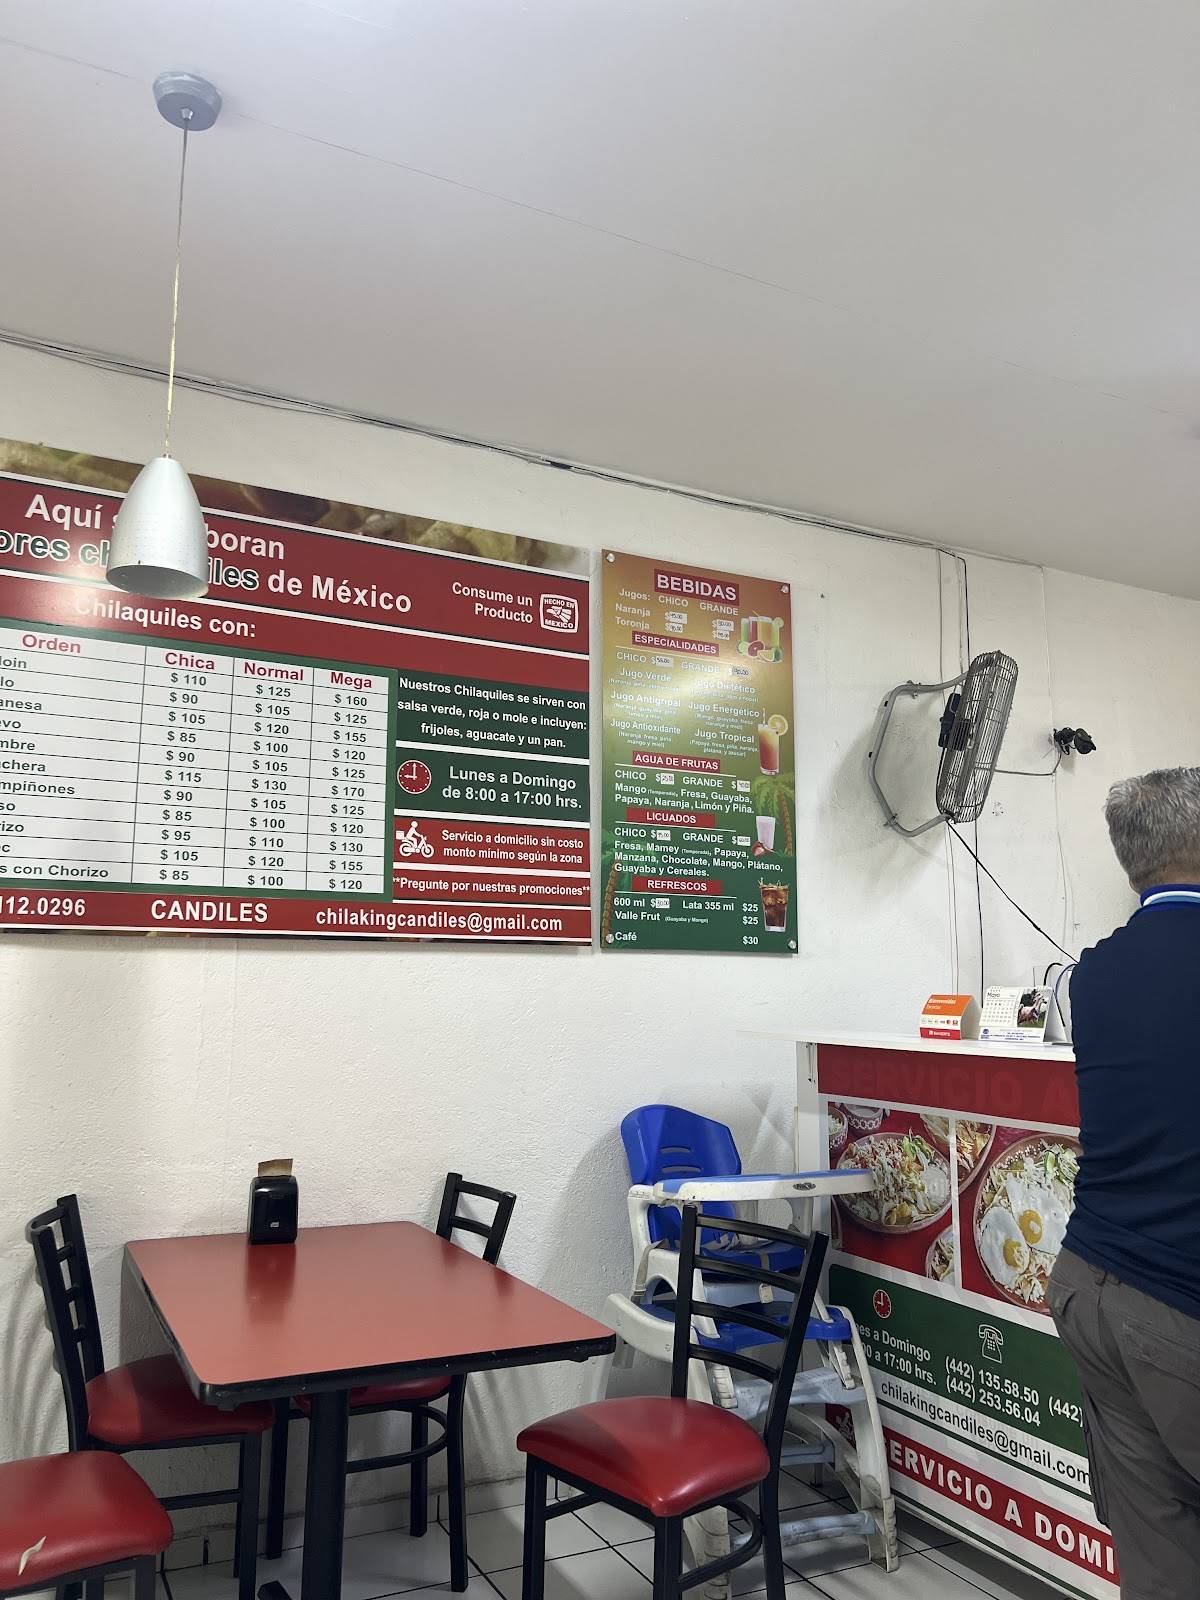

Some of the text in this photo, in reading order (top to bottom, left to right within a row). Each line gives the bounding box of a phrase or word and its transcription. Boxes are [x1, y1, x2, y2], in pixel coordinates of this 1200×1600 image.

[25, 494, 104, 530] Aquí
[204, 523, 285, 560] boran
[268, 570, 302, 596] de
[312, 575, 412, 613] México
[452, 582, 532, 607] Consume un
[657, 574, 737, 601] BEBIDAS
[615, 602, 651, 618] Naranja
[619, 588, 739, 616] Jugos: CHICO GRANDE
[74, 595, 256, 638] Chilaquiles con:
[475, 604, 534, 624] Producto
[544, 618, 574, 628] MEXICO
[615, 616, 650, 630] Toronja
[22, 634, 81, 654] Orden
[634, 634, 717, 654] ESPECIALIDADES
[165, 652, 216, 670] Chica
[616, 652, 647, 664] CHICO
[171, 672, 206, 686] $ 110
[244, 662, 304, 681] Normal
[620, 667, 672, 682] Jugo Verde
[330, 672, 372, 690] Mega
[256, 684, 292, 698] $ 125
[334, 693, 368, 707] $ 160
[399, 678, 586, 710] Nuestros Chilaquiles se sirven con
[610, 690, 634, 702] Jugo
[636, 692, 682, 708] Antigripal
[398, 700, 588, 730] salsa verde, roja o mole e incluyen:
[688, 700, 711, 712] Jugo
[420, 722, 566, 748] frijoles, aguacate y un pan.
[610, 718, 633, 730] Jugo
[634, 720, 682, 735] Antioxidante
[694, 728, 755, 744] Jugo Tropical
[634, 754, 718, 770] AGUA DE FRUTAS
[449, 766, 577, 792] Lunes a Domingo
[614, 770, 647, 781] CHICO
[682, 776, 723, 788] GRANDE
[442, 785, 582, 809] de 8:00 a 17:00 hrs.
[615, 782, 647, 795] Mango
[680, 789, 708, 800] Fresa,
[710, 790, 752, 804] Guayaba,
[615, 794, 652, 806] Papaya,
[724, 805, 730, 813] y
[732, 803, 754, 814] Piña.
[646, 812, 696, 824] LICUADOS
[442, 829, 584, 850] Servicio a domicilio sin costo
[614, 827, 647, 838] CHICO
[682, 832, 724, 844] GRANDE
[443, 846, 583, 864] monto mínimo según la zona
[614, 840, 644, 852] Fresa,
[646, 842, 680, 854] Mamey
[714, 848, 750, 860] Papaya,
[13, 864, 109, 878] con Chorizo
[614, 852, 783, 872] Manzana, Chocolate, Mango, Plátano,
[614, 864, 710, 878] Guayaba y Cereales.
[160, 870, 189, 881] $ 85
[248, 875, 284, 887] $ 100
[328, 878, 362, 890] $ 120
[452, 882, 470, 892] por
[472, 882, 516, 894] nuestras
[648, 880, 707, 892] REFRESCOS
[614, 898, 630, 906] 600
[634, 898, 646, 907] ml
[682, 900, 702, 910] Lata
[704, 901, 721, 910] 355
[723, 902, 734, 911] ml
[742, 902, 758, 912] $25
[151, 900, 268, 923] CANDILES
[316, 908, 562, 932] chilakingcandiles@gmail.com
[615, 910, 758, 925] Valle Frut $25
[614, 931, 758, 946] Café $30
[873, 1330, 880, 1341] a
[882, 1330, 931, 1362] Domingo
[874, 1350, 881, 1362] a
[884, 1351, 912, 1375] 17:00
[914, 1364, 937, 1386] hrs.
[945, 1356, 1040, 1406] (442) 135.58.50
[946, 1375, 1041, 1427] (442) 253.56.04
[881, 1380, 1090, 1484] chilakingcandiles@gmail.com
[886, 1439, 1114, 1574] ERVICIO A DOMI
